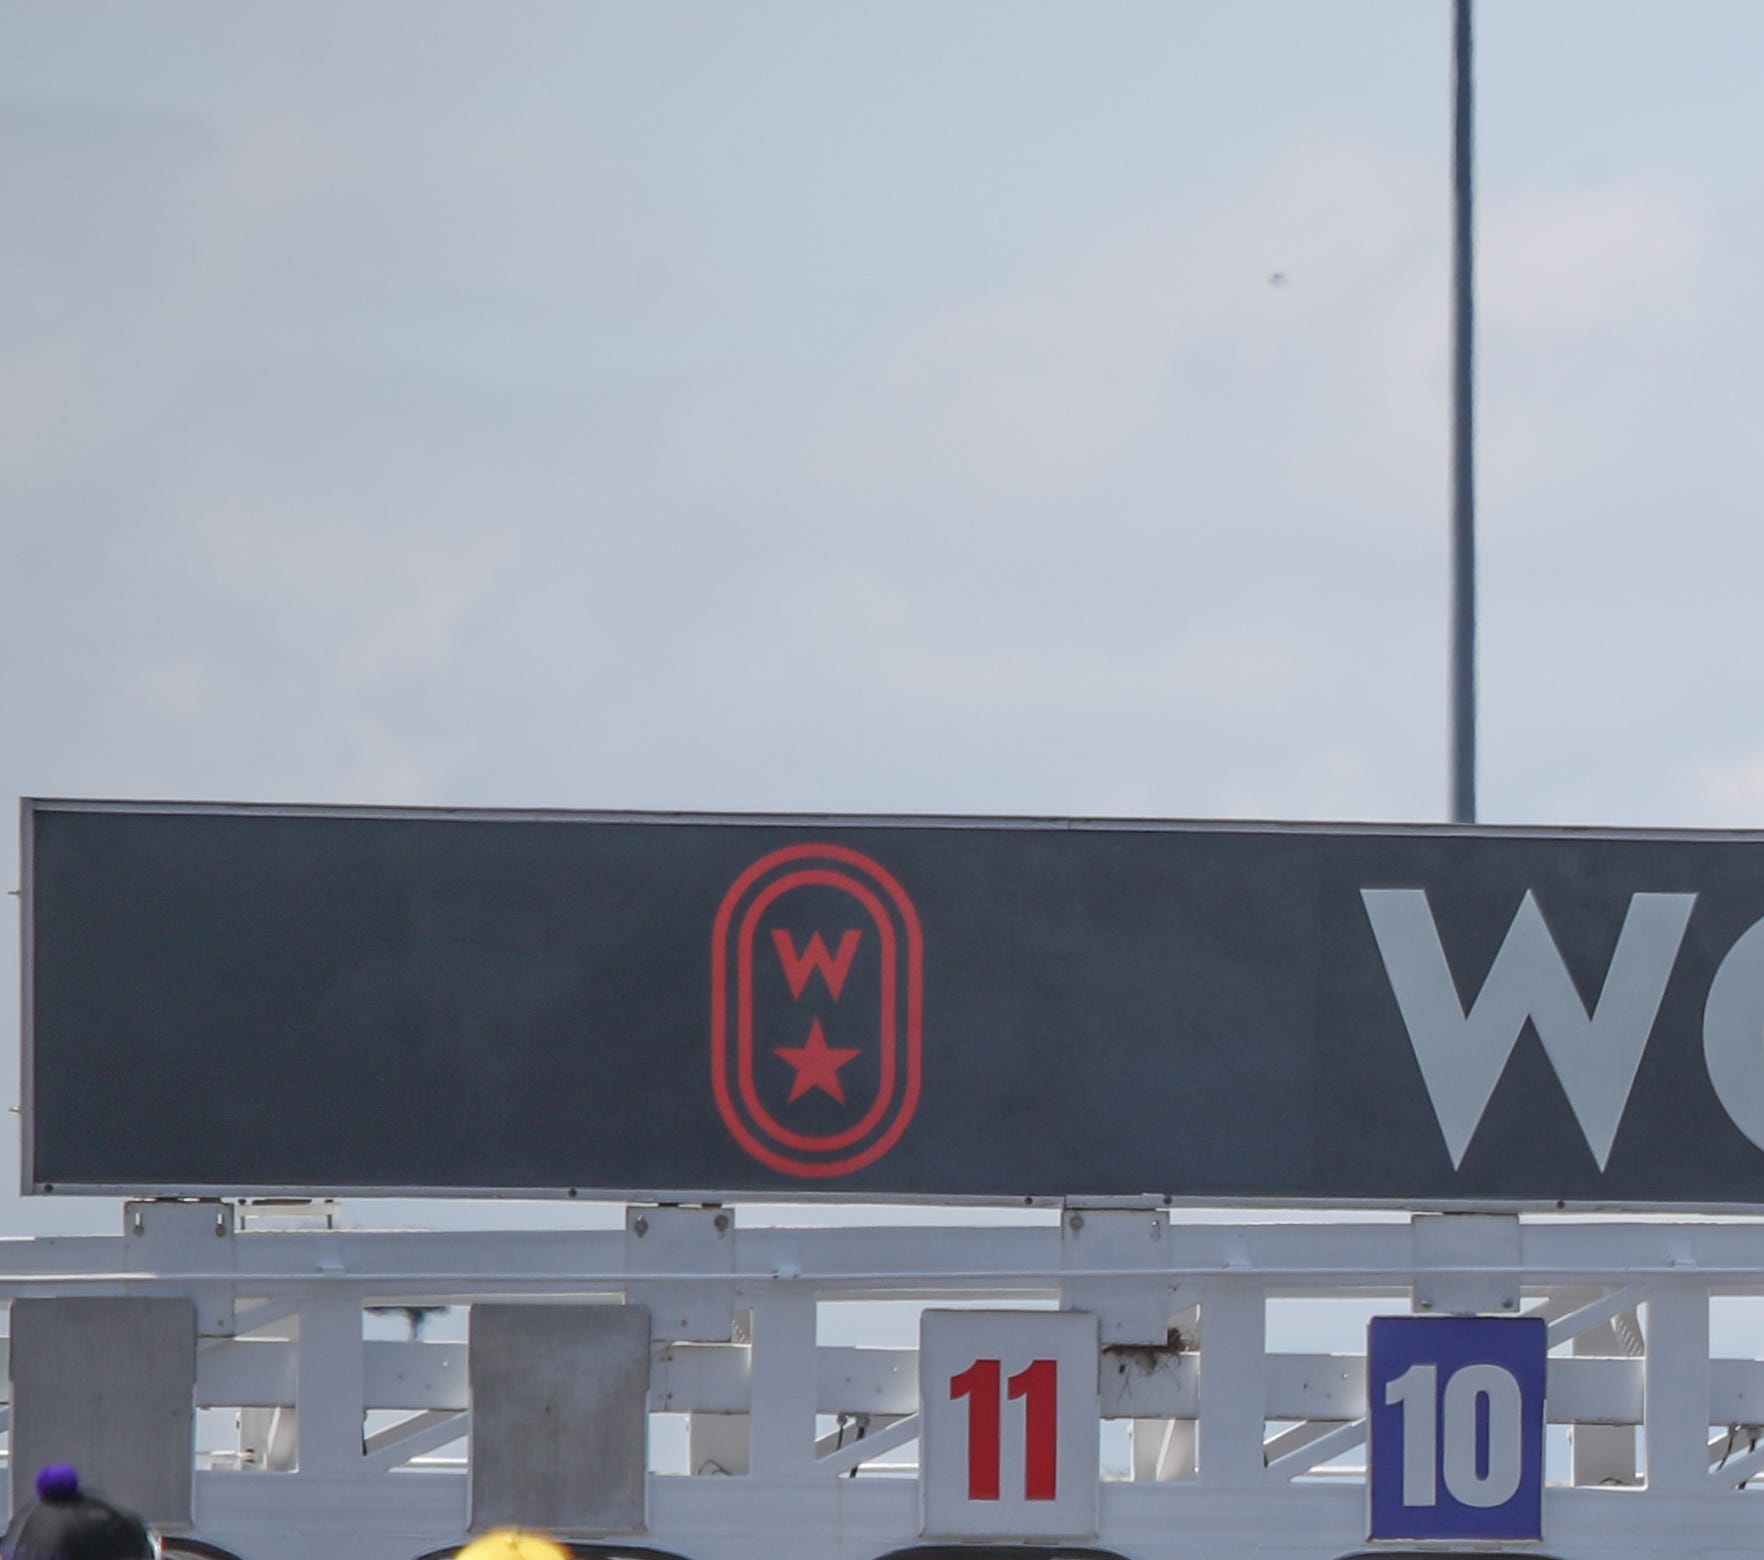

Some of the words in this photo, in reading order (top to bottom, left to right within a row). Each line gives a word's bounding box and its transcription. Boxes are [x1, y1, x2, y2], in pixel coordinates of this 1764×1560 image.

[771, 927, 862, 1002] W
[950, 1359, 1057, 1501] 11
[1385, 1363, 1523, 1508] 10
